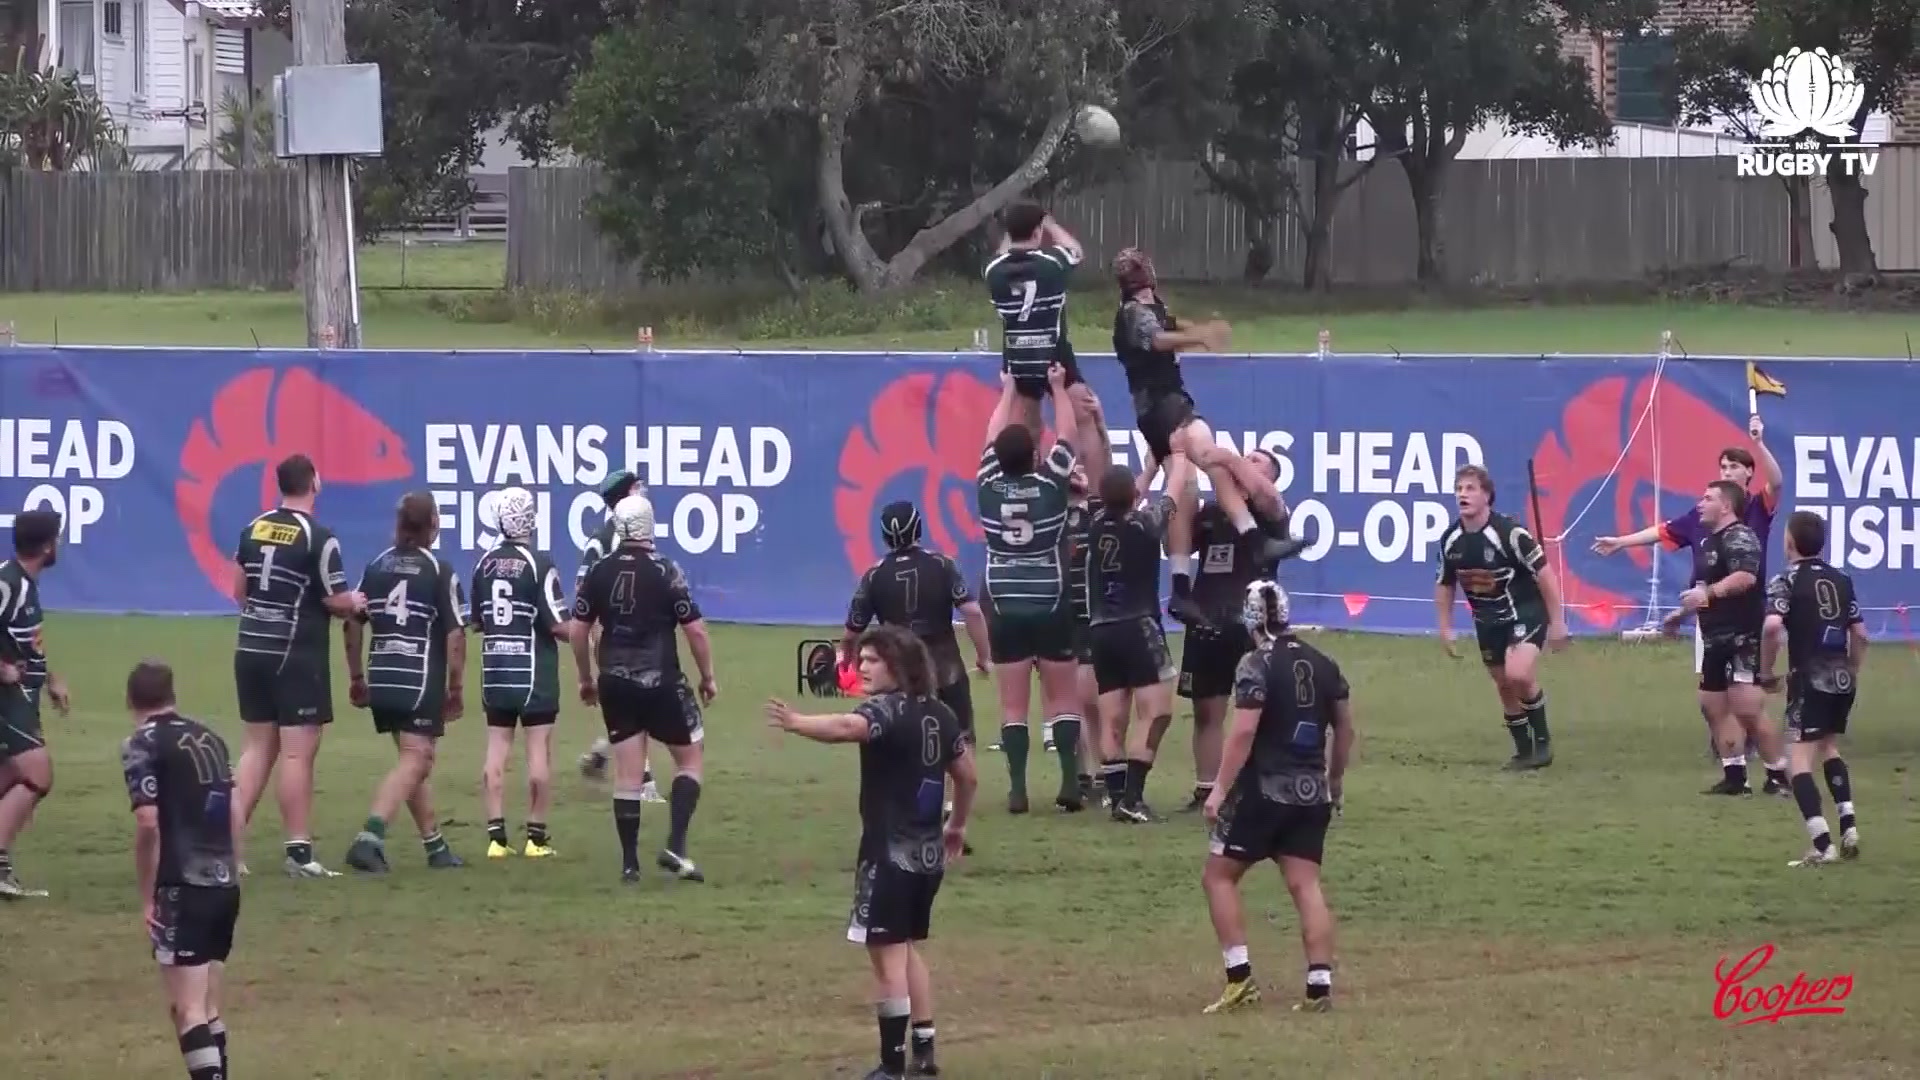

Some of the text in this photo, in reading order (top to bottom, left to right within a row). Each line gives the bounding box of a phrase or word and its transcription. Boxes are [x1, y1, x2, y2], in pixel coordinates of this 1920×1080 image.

[1010, 280, 1037, 322] 7
[426, 424, 792, 487] EVANS HEAD
[1794, 435, 1920, 499] EVA
[568, 491, 759, 554] C-OP
[1001, 503, 1034, 546] 5
[1286, 499, 1449, 563] O-OP
[260, 545, 276, 591] 1
[1099, 534, 1121, 572] 2
[385, 580, 409, 626] 4
[492, 579, 513, 626] 6
[609, 571, 636, 615] 4
[895, 568, 920, 613] 7
[1814, 578, 1841, 621] 9
[1293, 659, 1315, 708] 8
[177, 731, 232, 785] 11
[921, 715, 941, 767] 6
